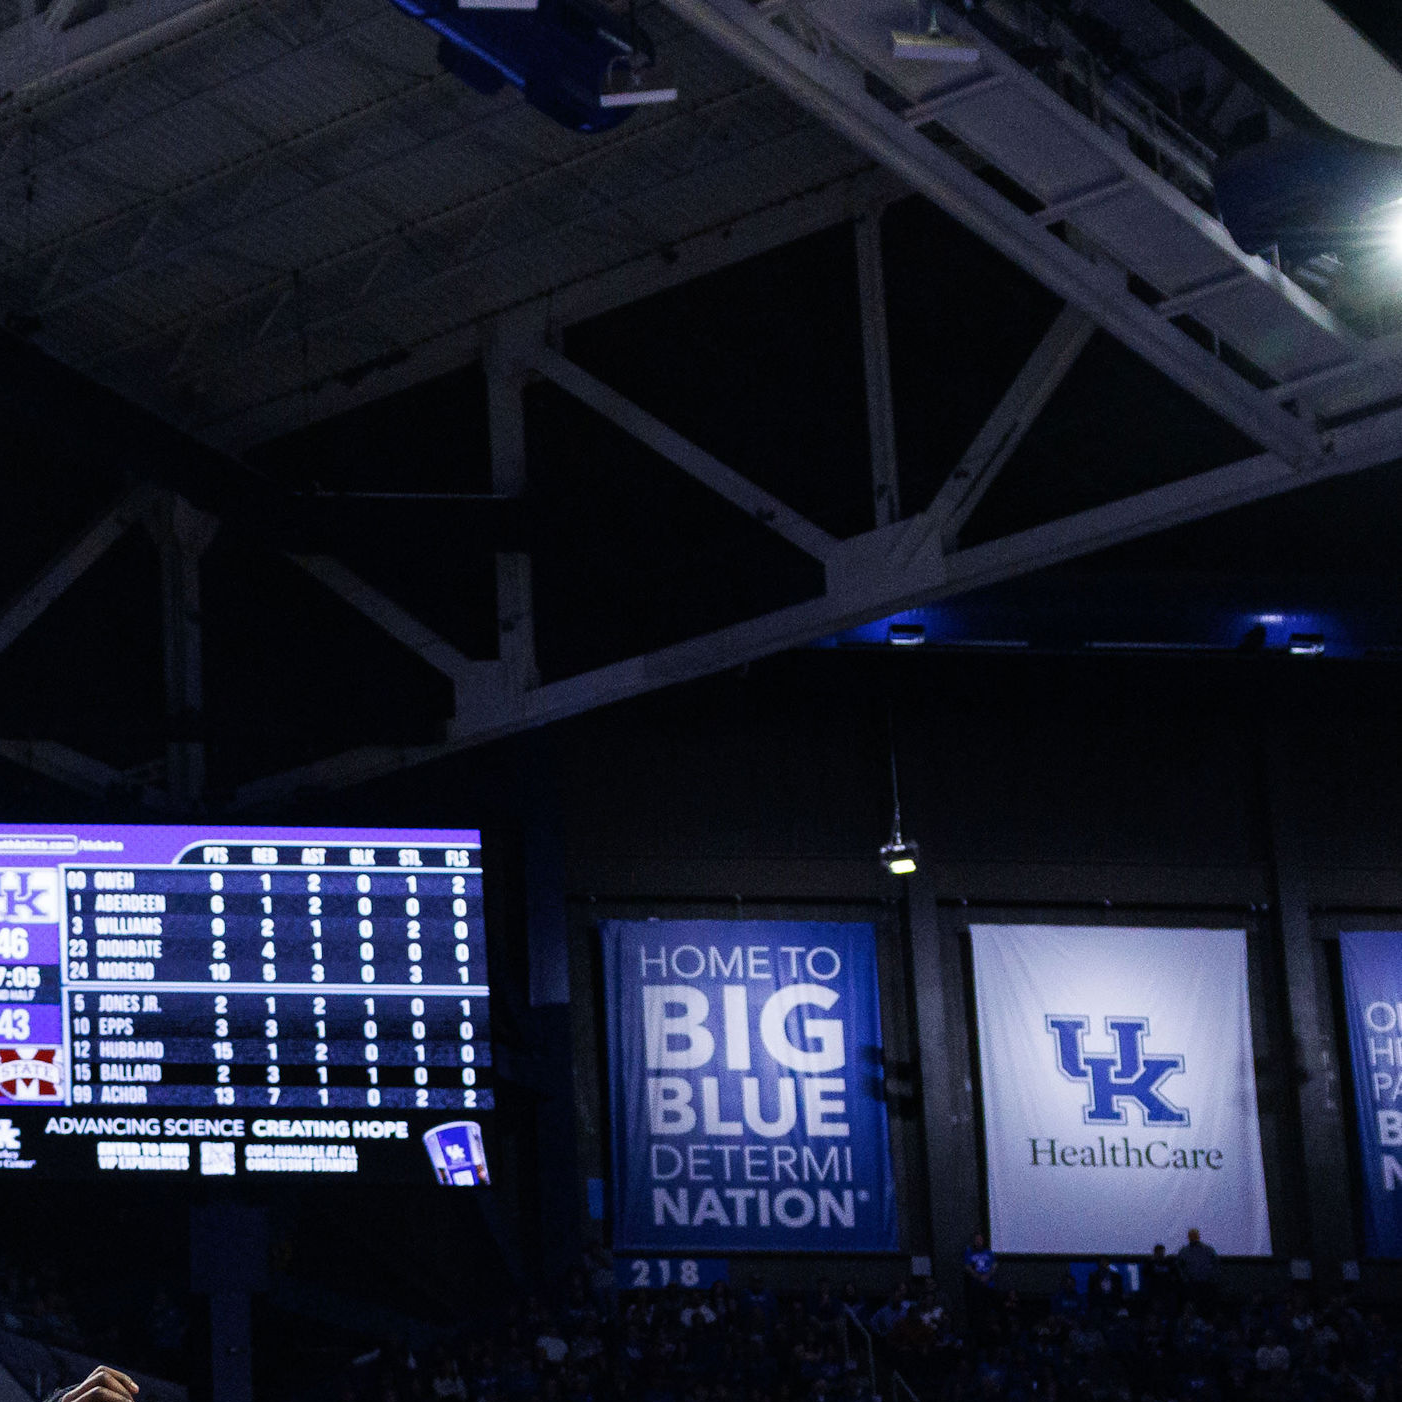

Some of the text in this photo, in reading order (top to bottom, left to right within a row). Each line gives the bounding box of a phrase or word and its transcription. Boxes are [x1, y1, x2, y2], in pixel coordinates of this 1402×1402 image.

[203, 847, 469, 867] PTS REB AST BLK STL FLS
[66, 871, 86, 889] 00
[210, 872, 223, 891] 9
[260, 873, 271, 891] 1
[308, 874, 321, 892] 2
[357, 874, 371, 893] 0
[406, 875, 417, 893] 1
[452, 876, 465, 894] 2
[73, 894, 466, 917] 1 ABERDEEN 6 1 2 0 0 0
[72, 916, 468, 939] 3 WILLIAMS 9 2 1 0 2 0
[68, 939, 469, 962] 23 DIOUBATE 2 4 1 0 0 0
[68, 961, 469, 984] 24 MORENO 10 5 3 0 3 1
[640, 945, 842, 981] HOME TO
[75, 994, 470, 1016] 5 JONES JR. 2 1 2 1 0 1
[74, 1017, 473, 1040] 10 EPPS 3 3 1 0 0 0
[643, 983, 846, 1073] BIG
[74, 1041, 474, 1062] 12 HUBBARD 15 1 2 0 1 0
[75, 1064, 475, 1085] 15 BALLARD 2 3 1 1 0 0
[1046, 1013, 1190, 1128] UK
[101, 1086, 147, 1103] ACHOR
[214, 1087, 235, 1105] 13
[268, 1087, 280, 1105] 7
[318, 1088, 328, 1105] 1
[368, 1089, 380, 1106] 0
[416, 1089, 428, 1107] 2
[464, 1090, 476, 1107] 2
[647, 1076, 849, 1138] BLUE
[45, 1117, 409, 1139] ADVANCING SCIENCE CREATING HOPE
[652, 1145, 852, 1182] DETERMI
[1030, 1136, 1224, 1171] HealthCare
[631, 1259, 699, 1287] 218
